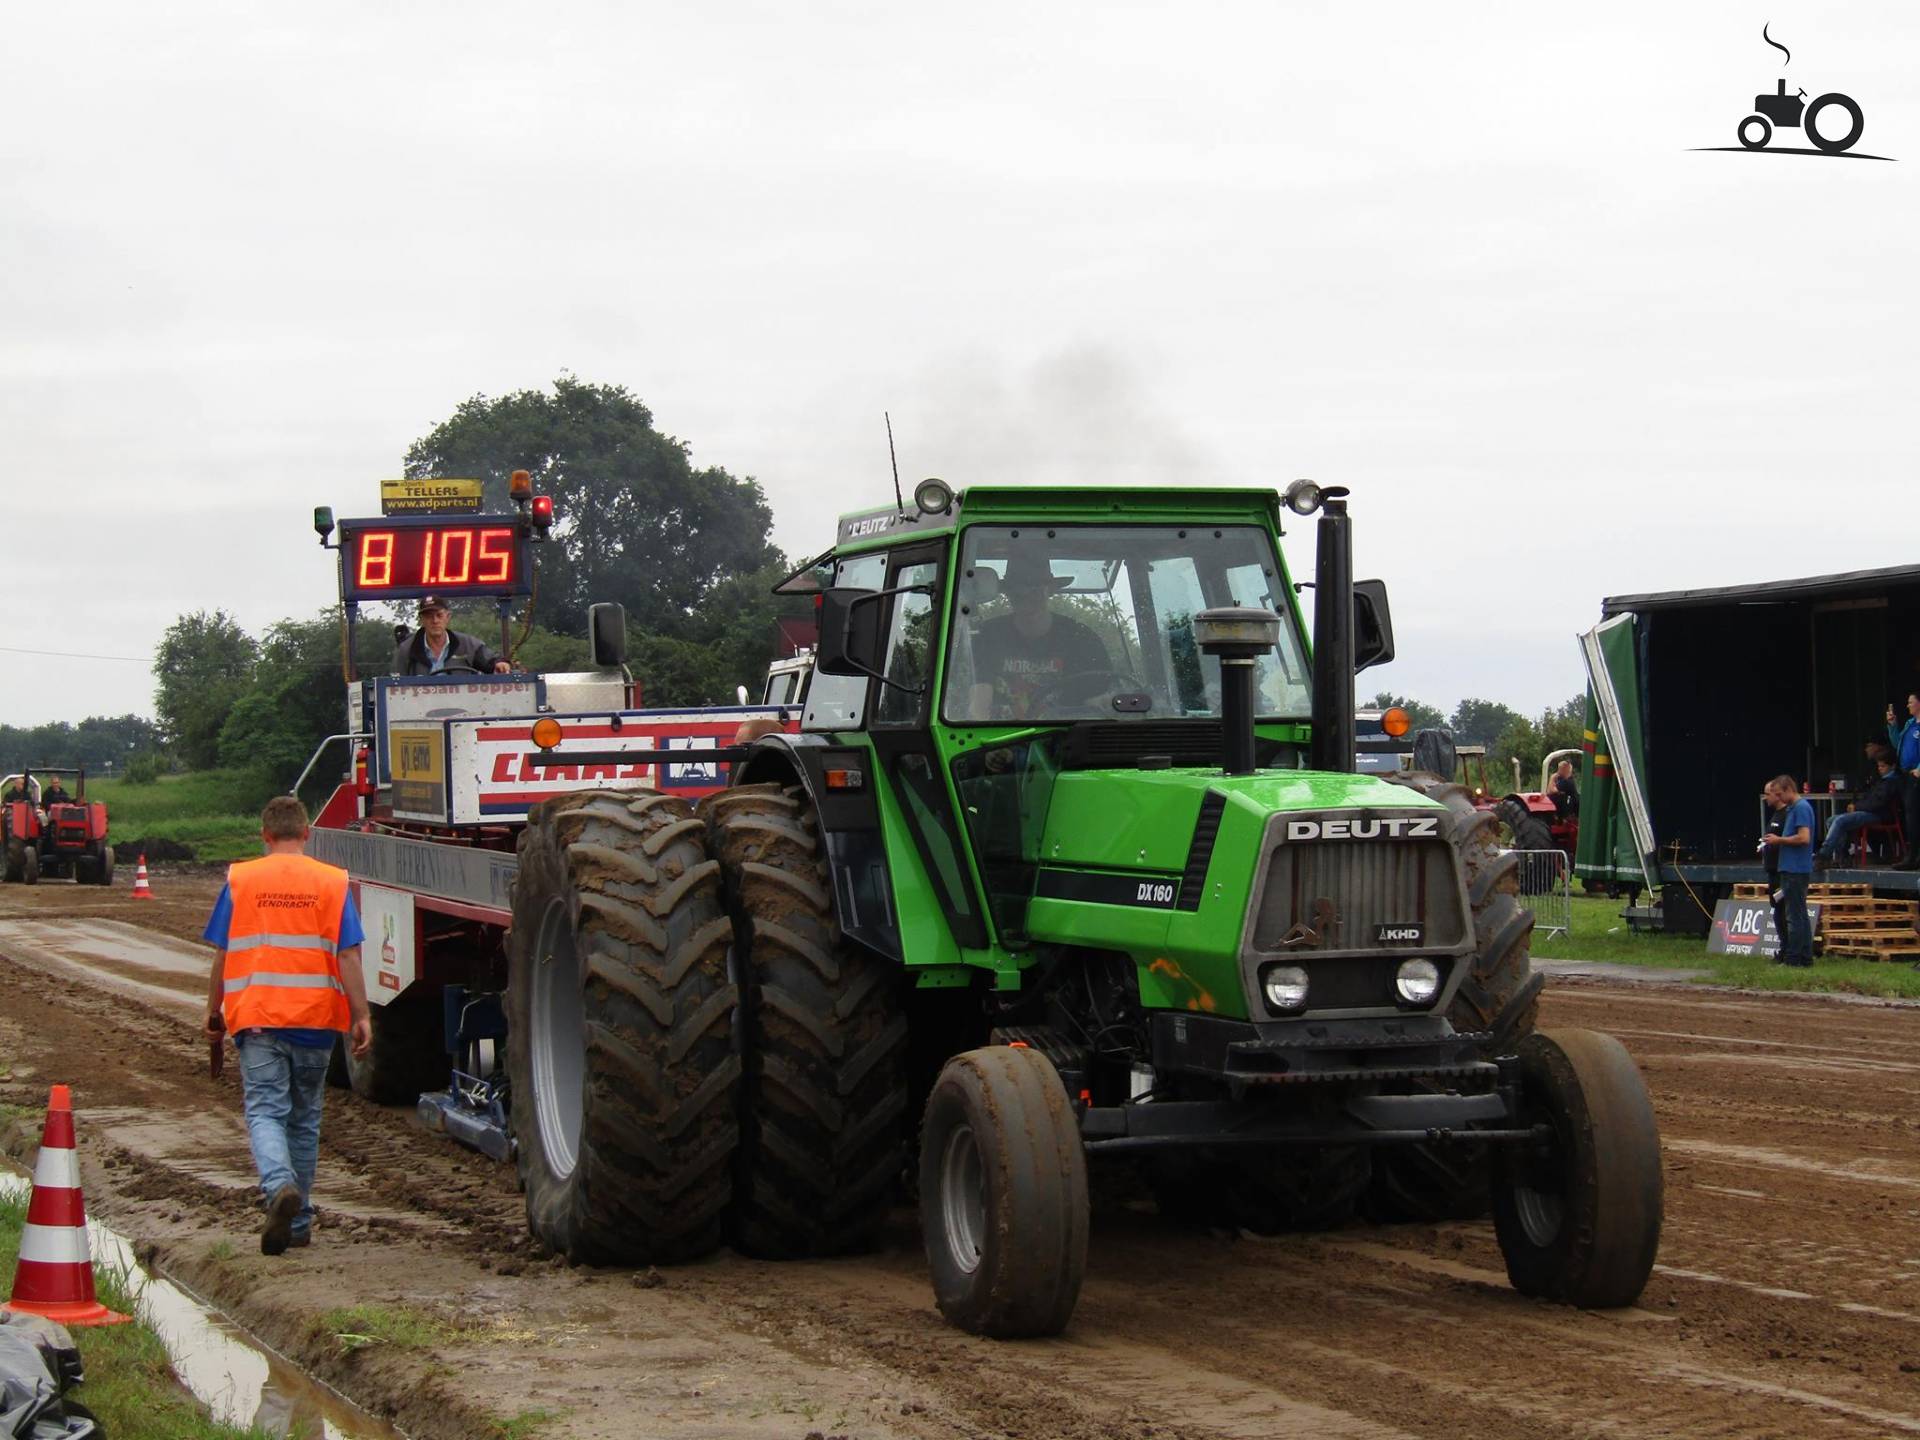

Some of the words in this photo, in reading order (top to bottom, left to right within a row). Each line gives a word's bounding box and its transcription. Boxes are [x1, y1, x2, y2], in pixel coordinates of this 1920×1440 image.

[405, 487, 459, 497] TELLERS
[387, 498, 478, 510] www.adparts.nl
[1287, 817, 1438, 840] DEUTZ
[1136, 883, 1173, 902] DX160
[1731, 908, 1764, 935] ABC
[1387, 929, 1420, 940] KHD
